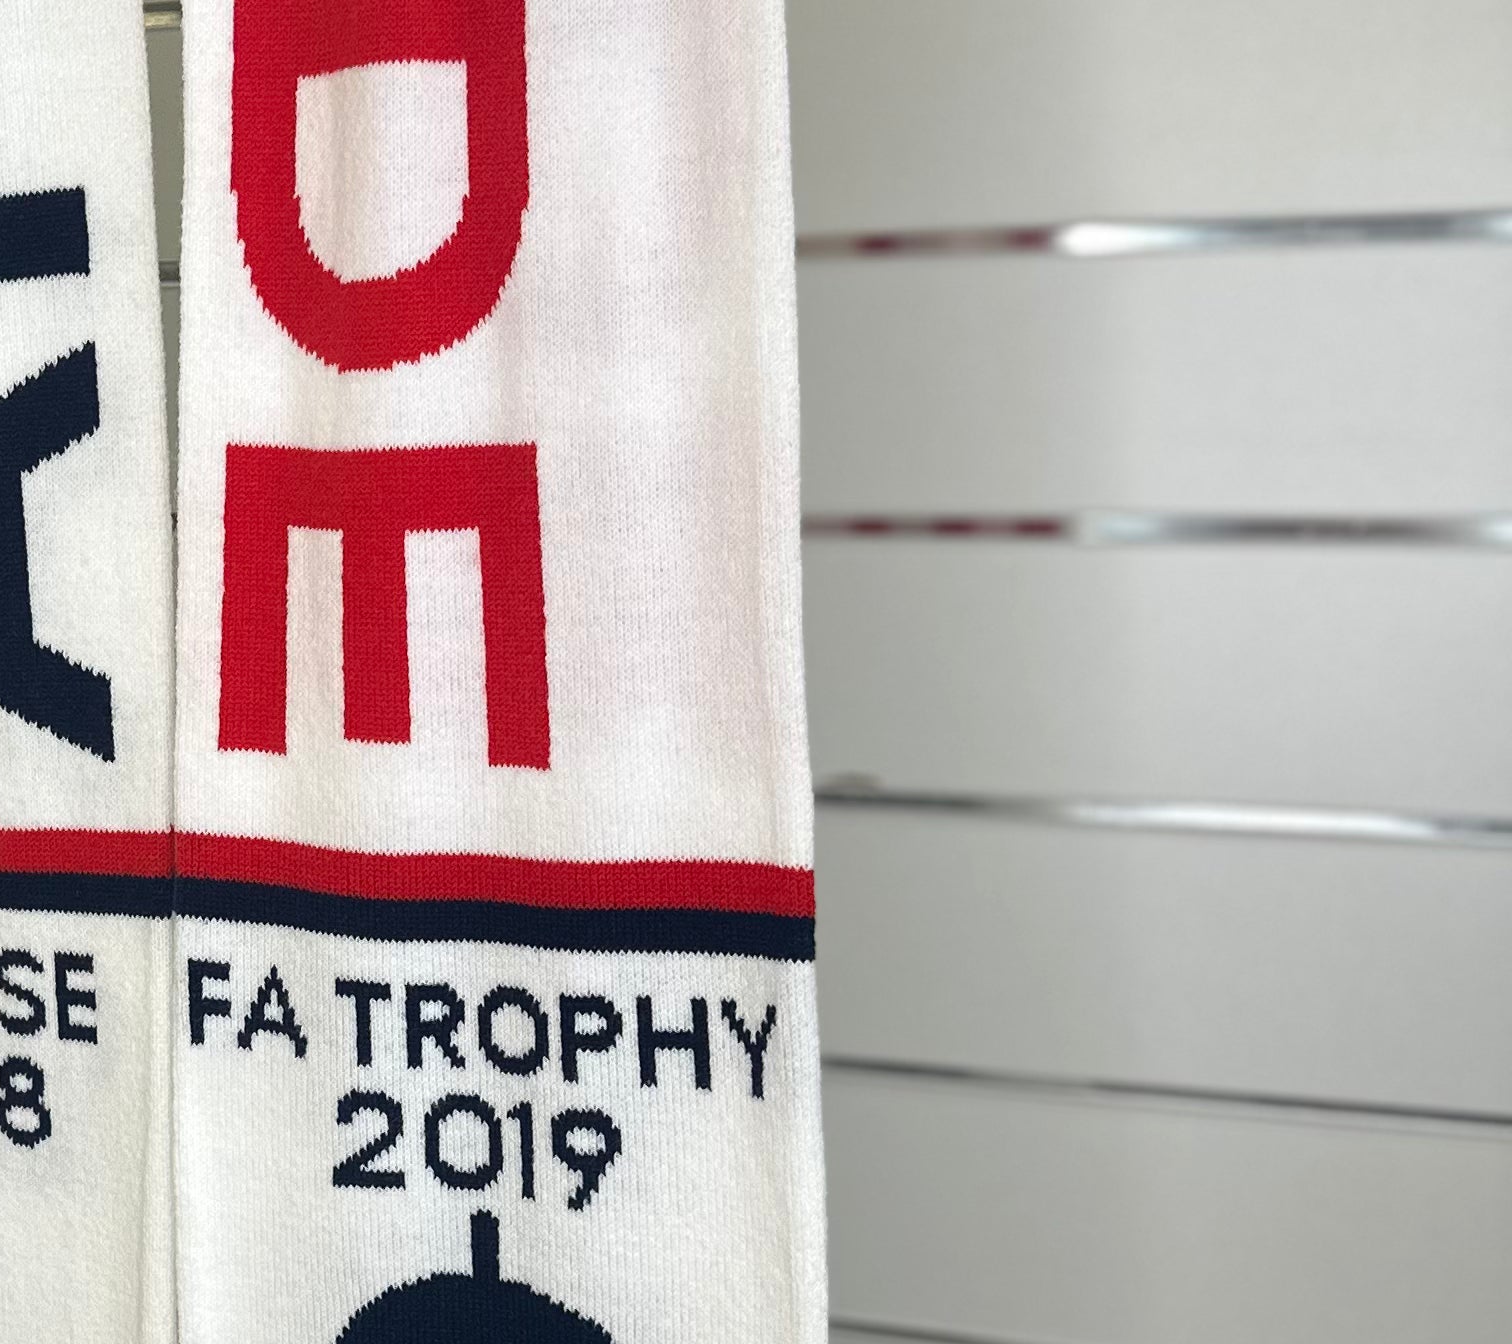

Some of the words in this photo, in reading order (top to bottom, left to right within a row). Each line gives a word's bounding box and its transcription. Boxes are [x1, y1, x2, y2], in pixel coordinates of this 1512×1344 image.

[187, 957, 308, 1058] FA
[334, 976, 777, 1100] TROPHY
[332, 1088, 623, 1211] 2019
